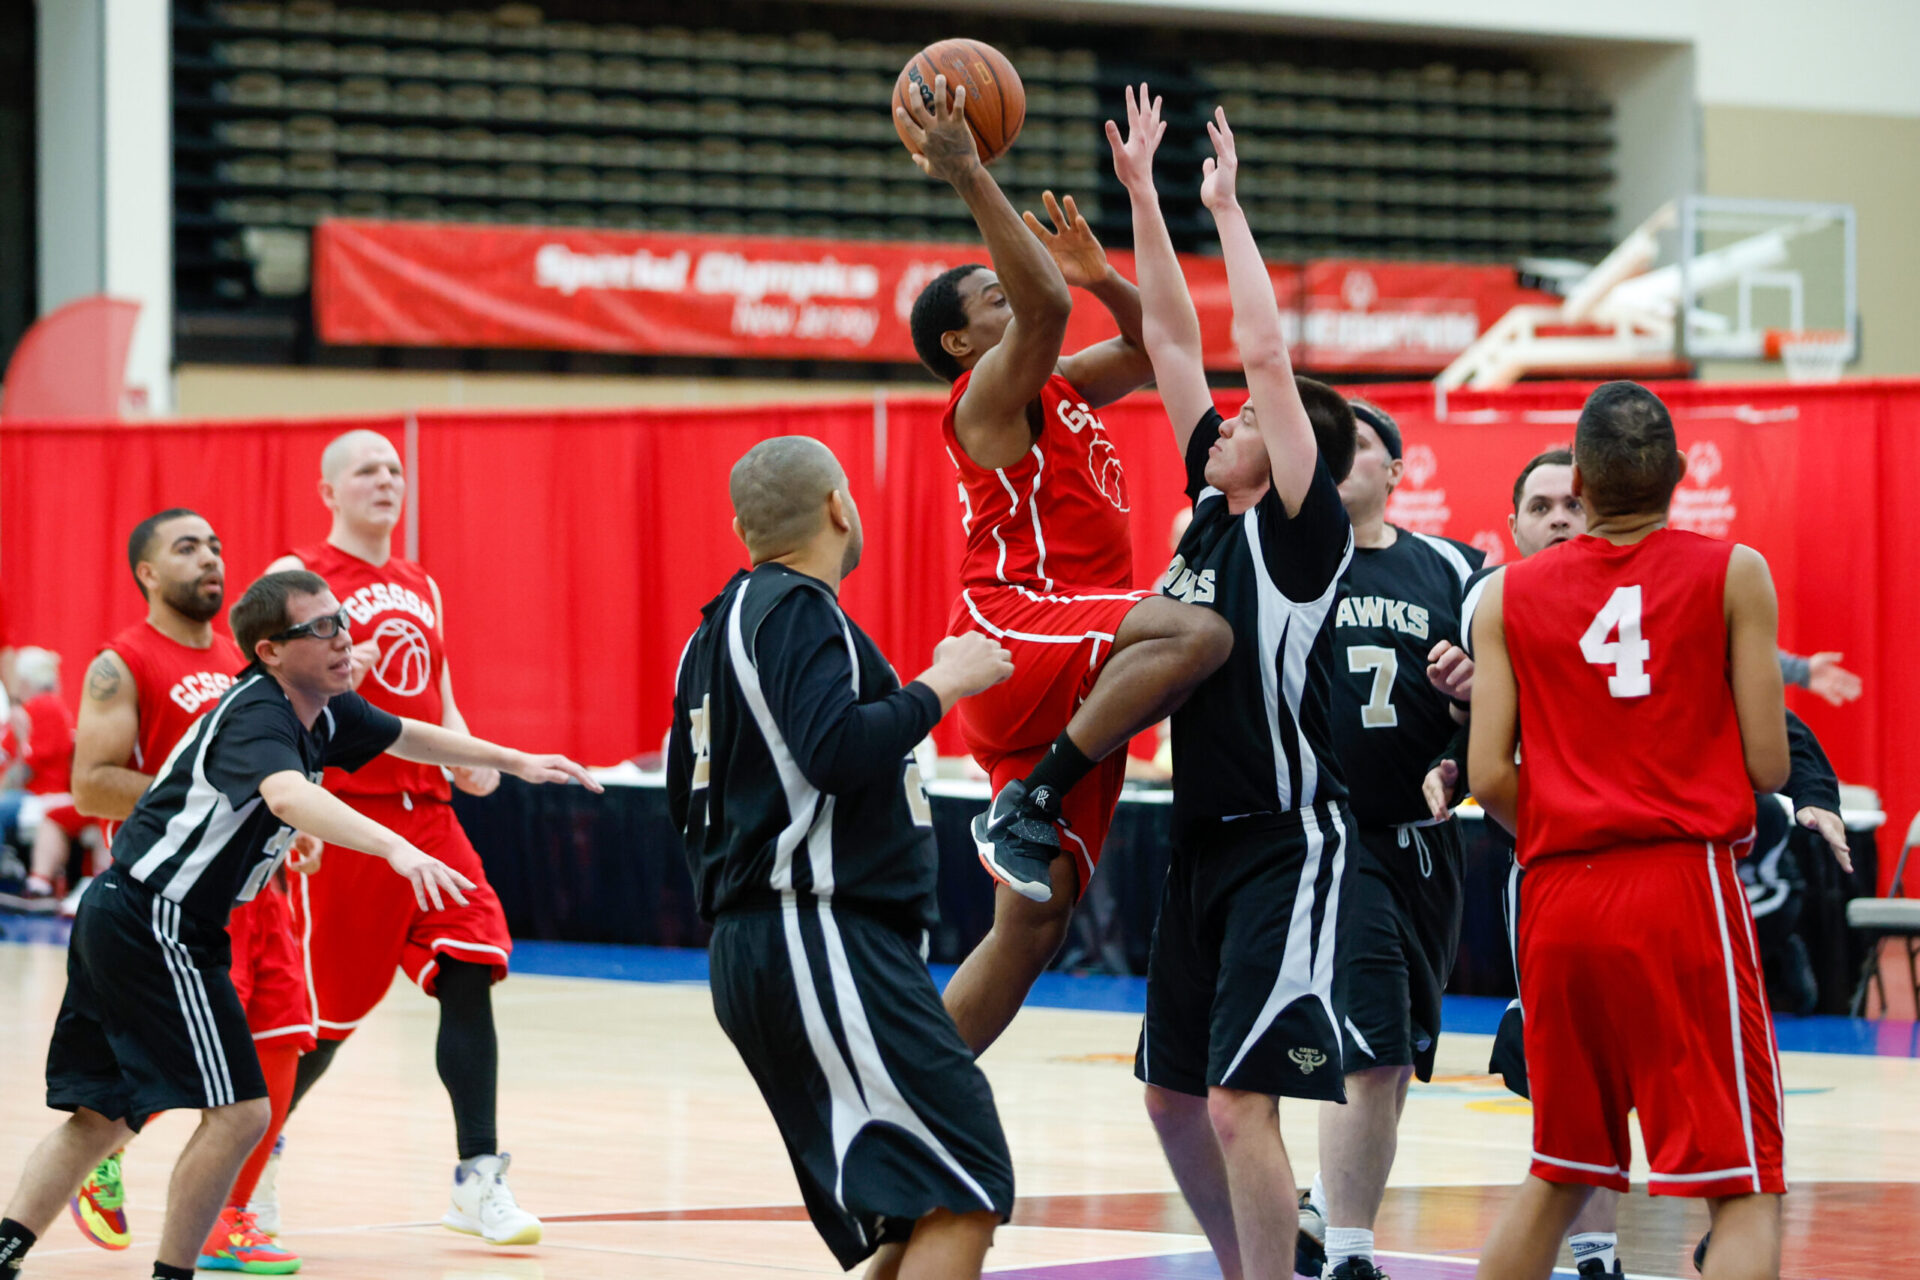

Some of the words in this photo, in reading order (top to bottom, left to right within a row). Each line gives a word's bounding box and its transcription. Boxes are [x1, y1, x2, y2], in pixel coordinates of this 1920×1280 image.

[1578, 584, 1651, 698] 4
[169, 671, 241, 714] GCSS
[1347, 645, 1398, 728] 7
